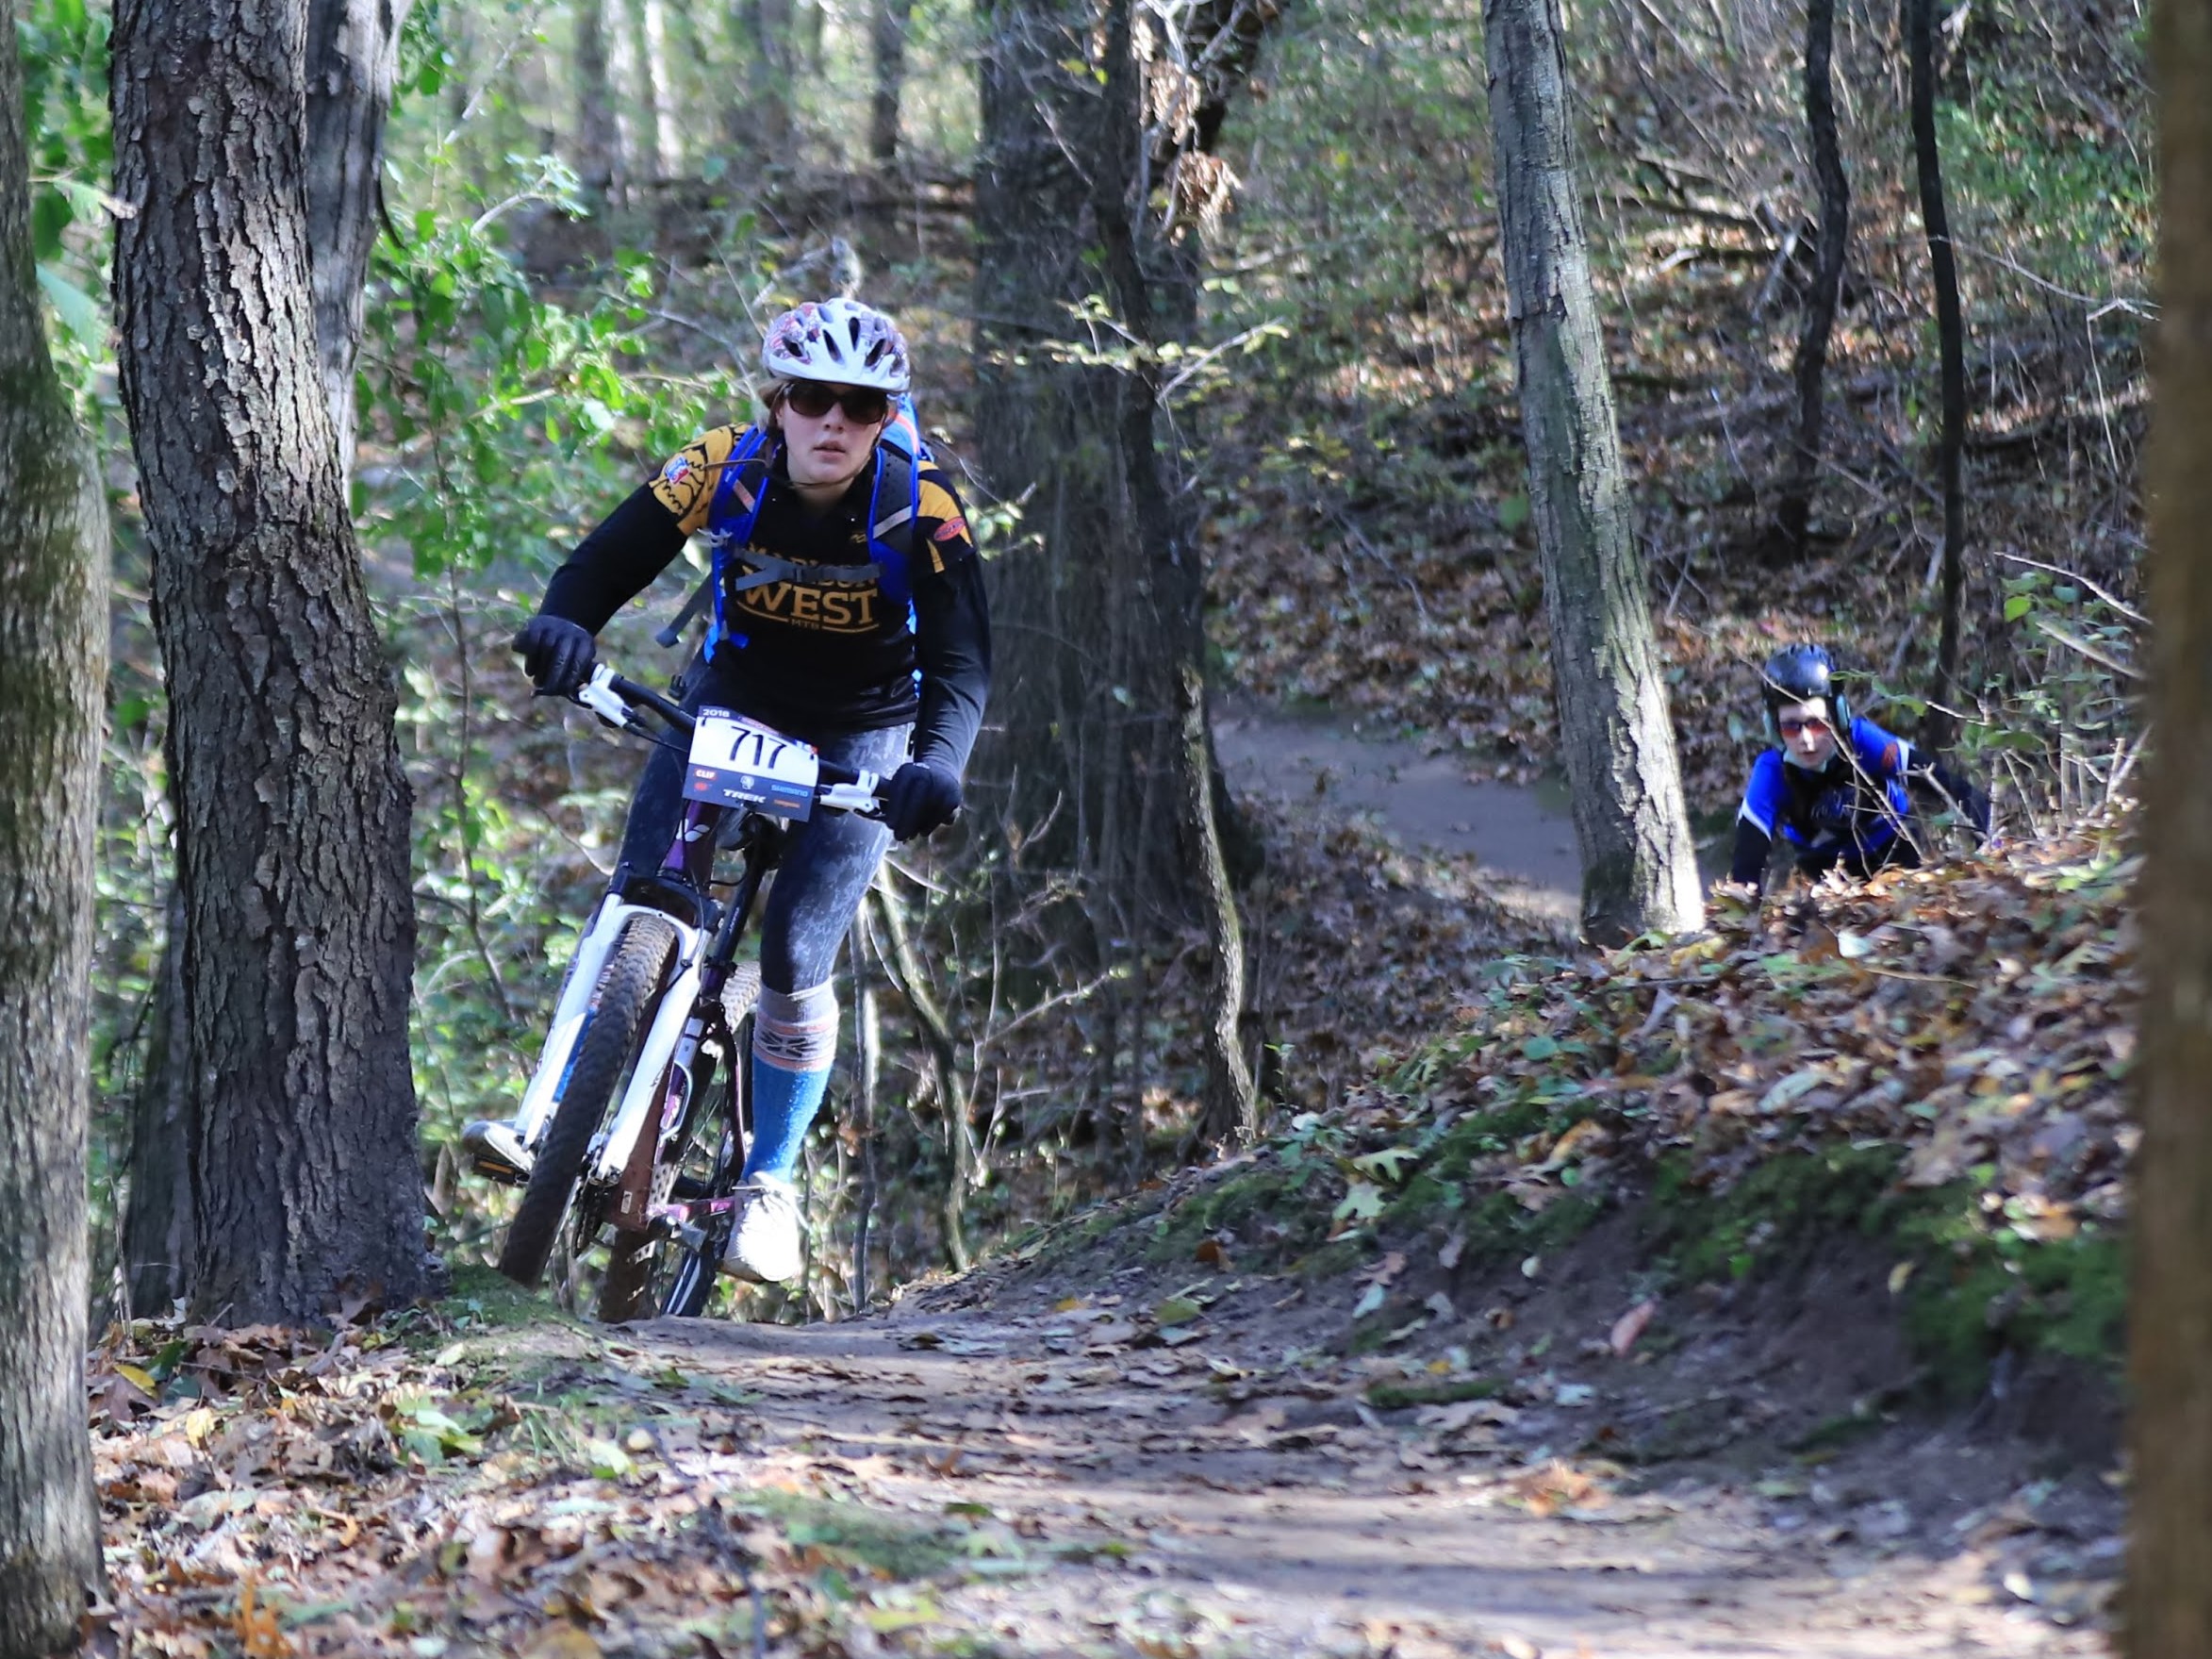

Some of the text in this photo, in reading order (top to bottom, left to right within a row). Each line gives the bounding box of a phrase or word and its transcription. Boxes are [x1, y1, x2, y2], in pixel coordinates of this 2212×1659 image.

[742, 566, 878, 624] WEST
[702, 708, 730, 718] 2018
[730, 725, 787, 769] 717
[695, 770, 716, 779] CLIF
[723, 788, 766, 804] TREK
[771, 784, 808, 797] SHIMANO
